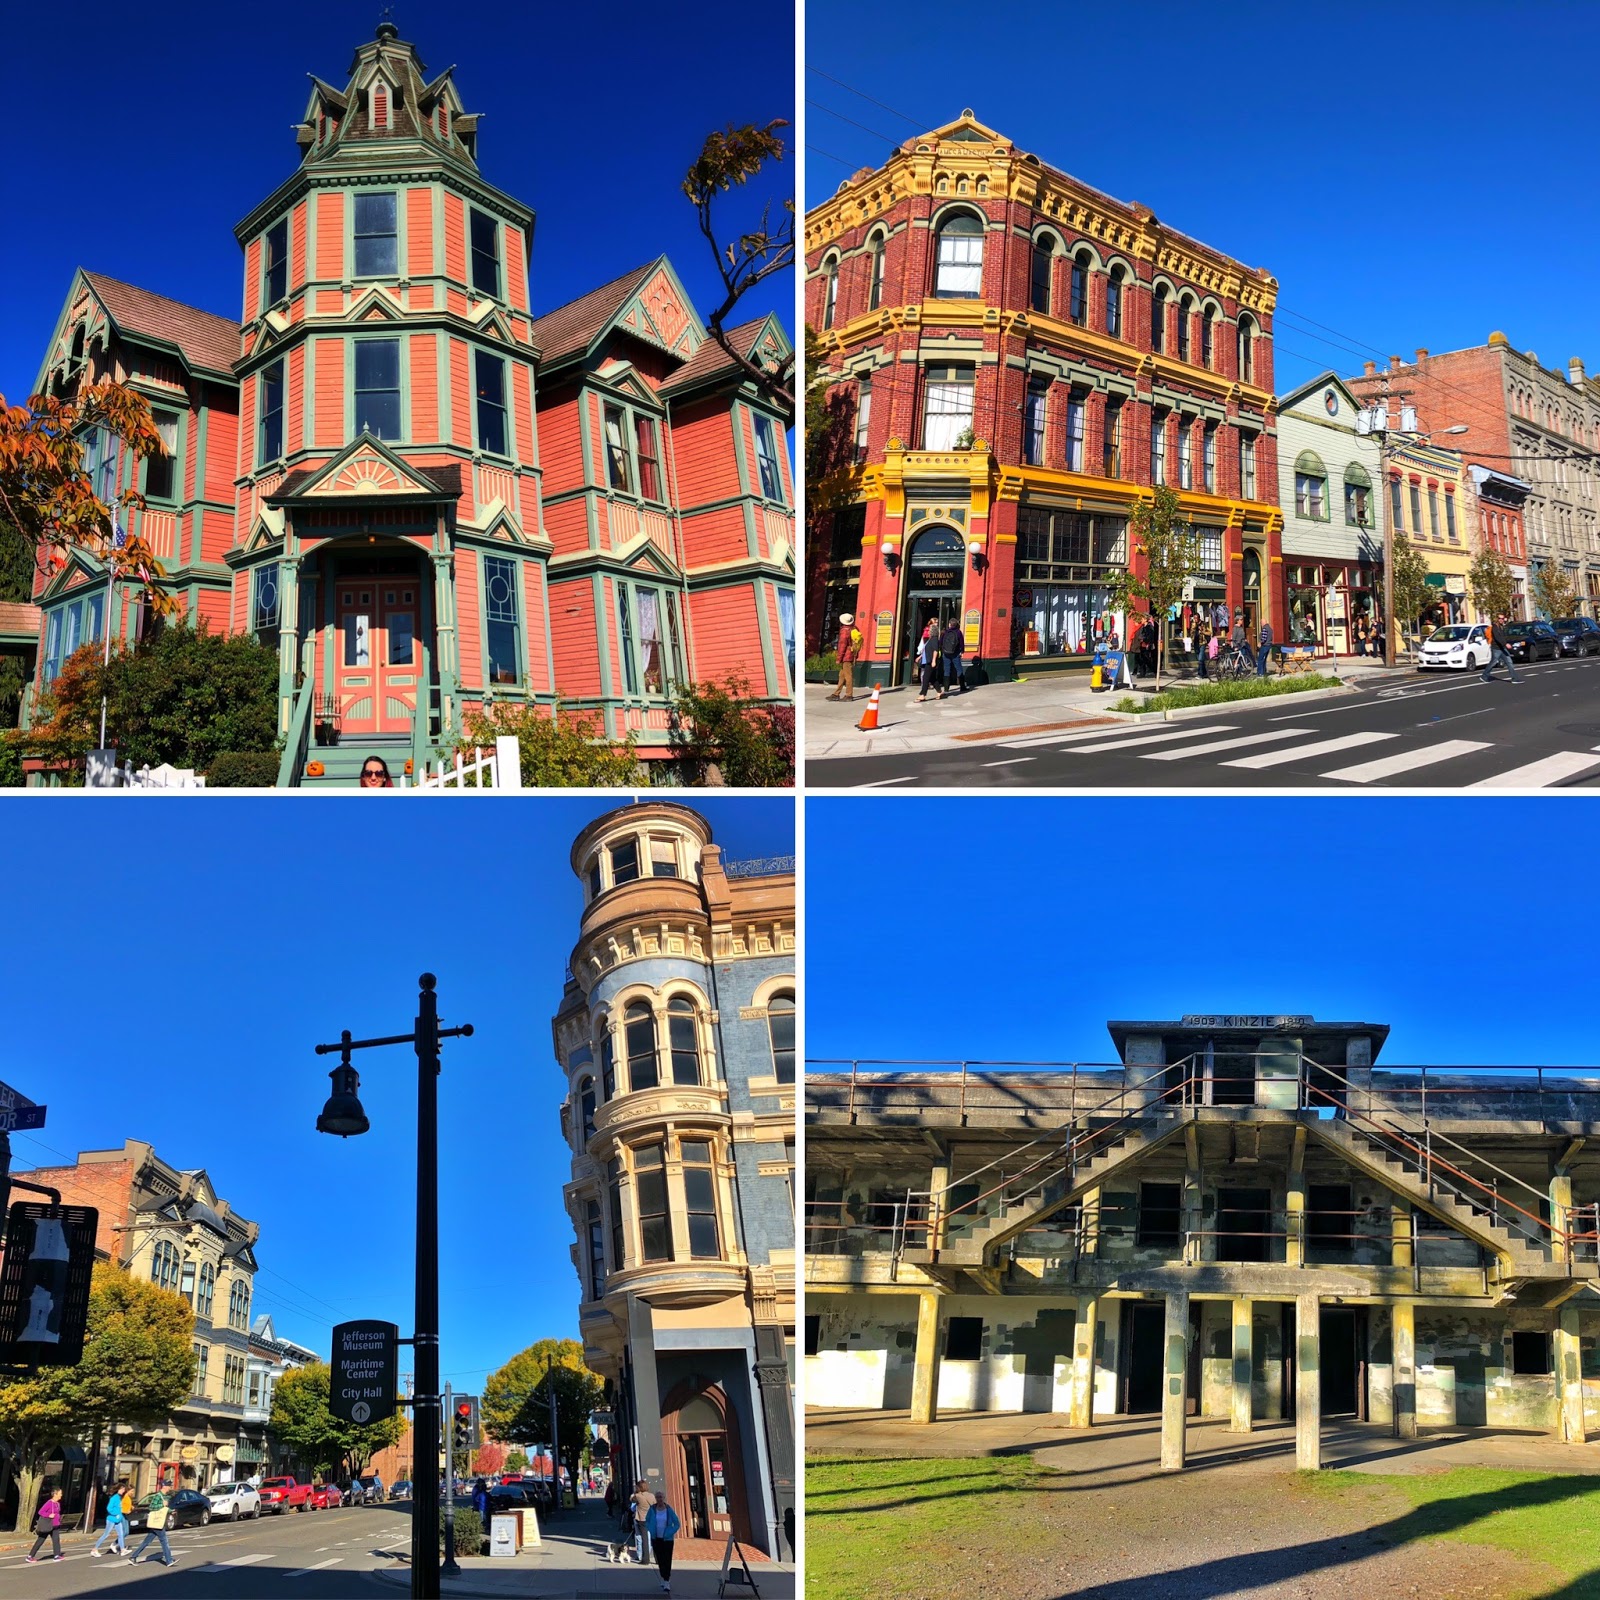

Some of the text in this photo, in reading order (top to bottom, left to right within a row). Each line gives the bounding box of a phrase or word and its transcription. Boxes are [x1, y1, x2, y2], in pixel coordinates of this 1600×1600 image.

[1190, 1017, 1215, 1025] 1909
[1223, 1017, 1275, 1026] KINZIE
[26, 1114, 37, 1123] ST
[342, 1331, 385, 1342] Jefferson
[343, 1341, 383, 1351] Museum
[341, 1359, 384, 1370] Maritime
[346, 1369, 379, 1379] Center
[341, 1387, 382, 1400] City Hall
